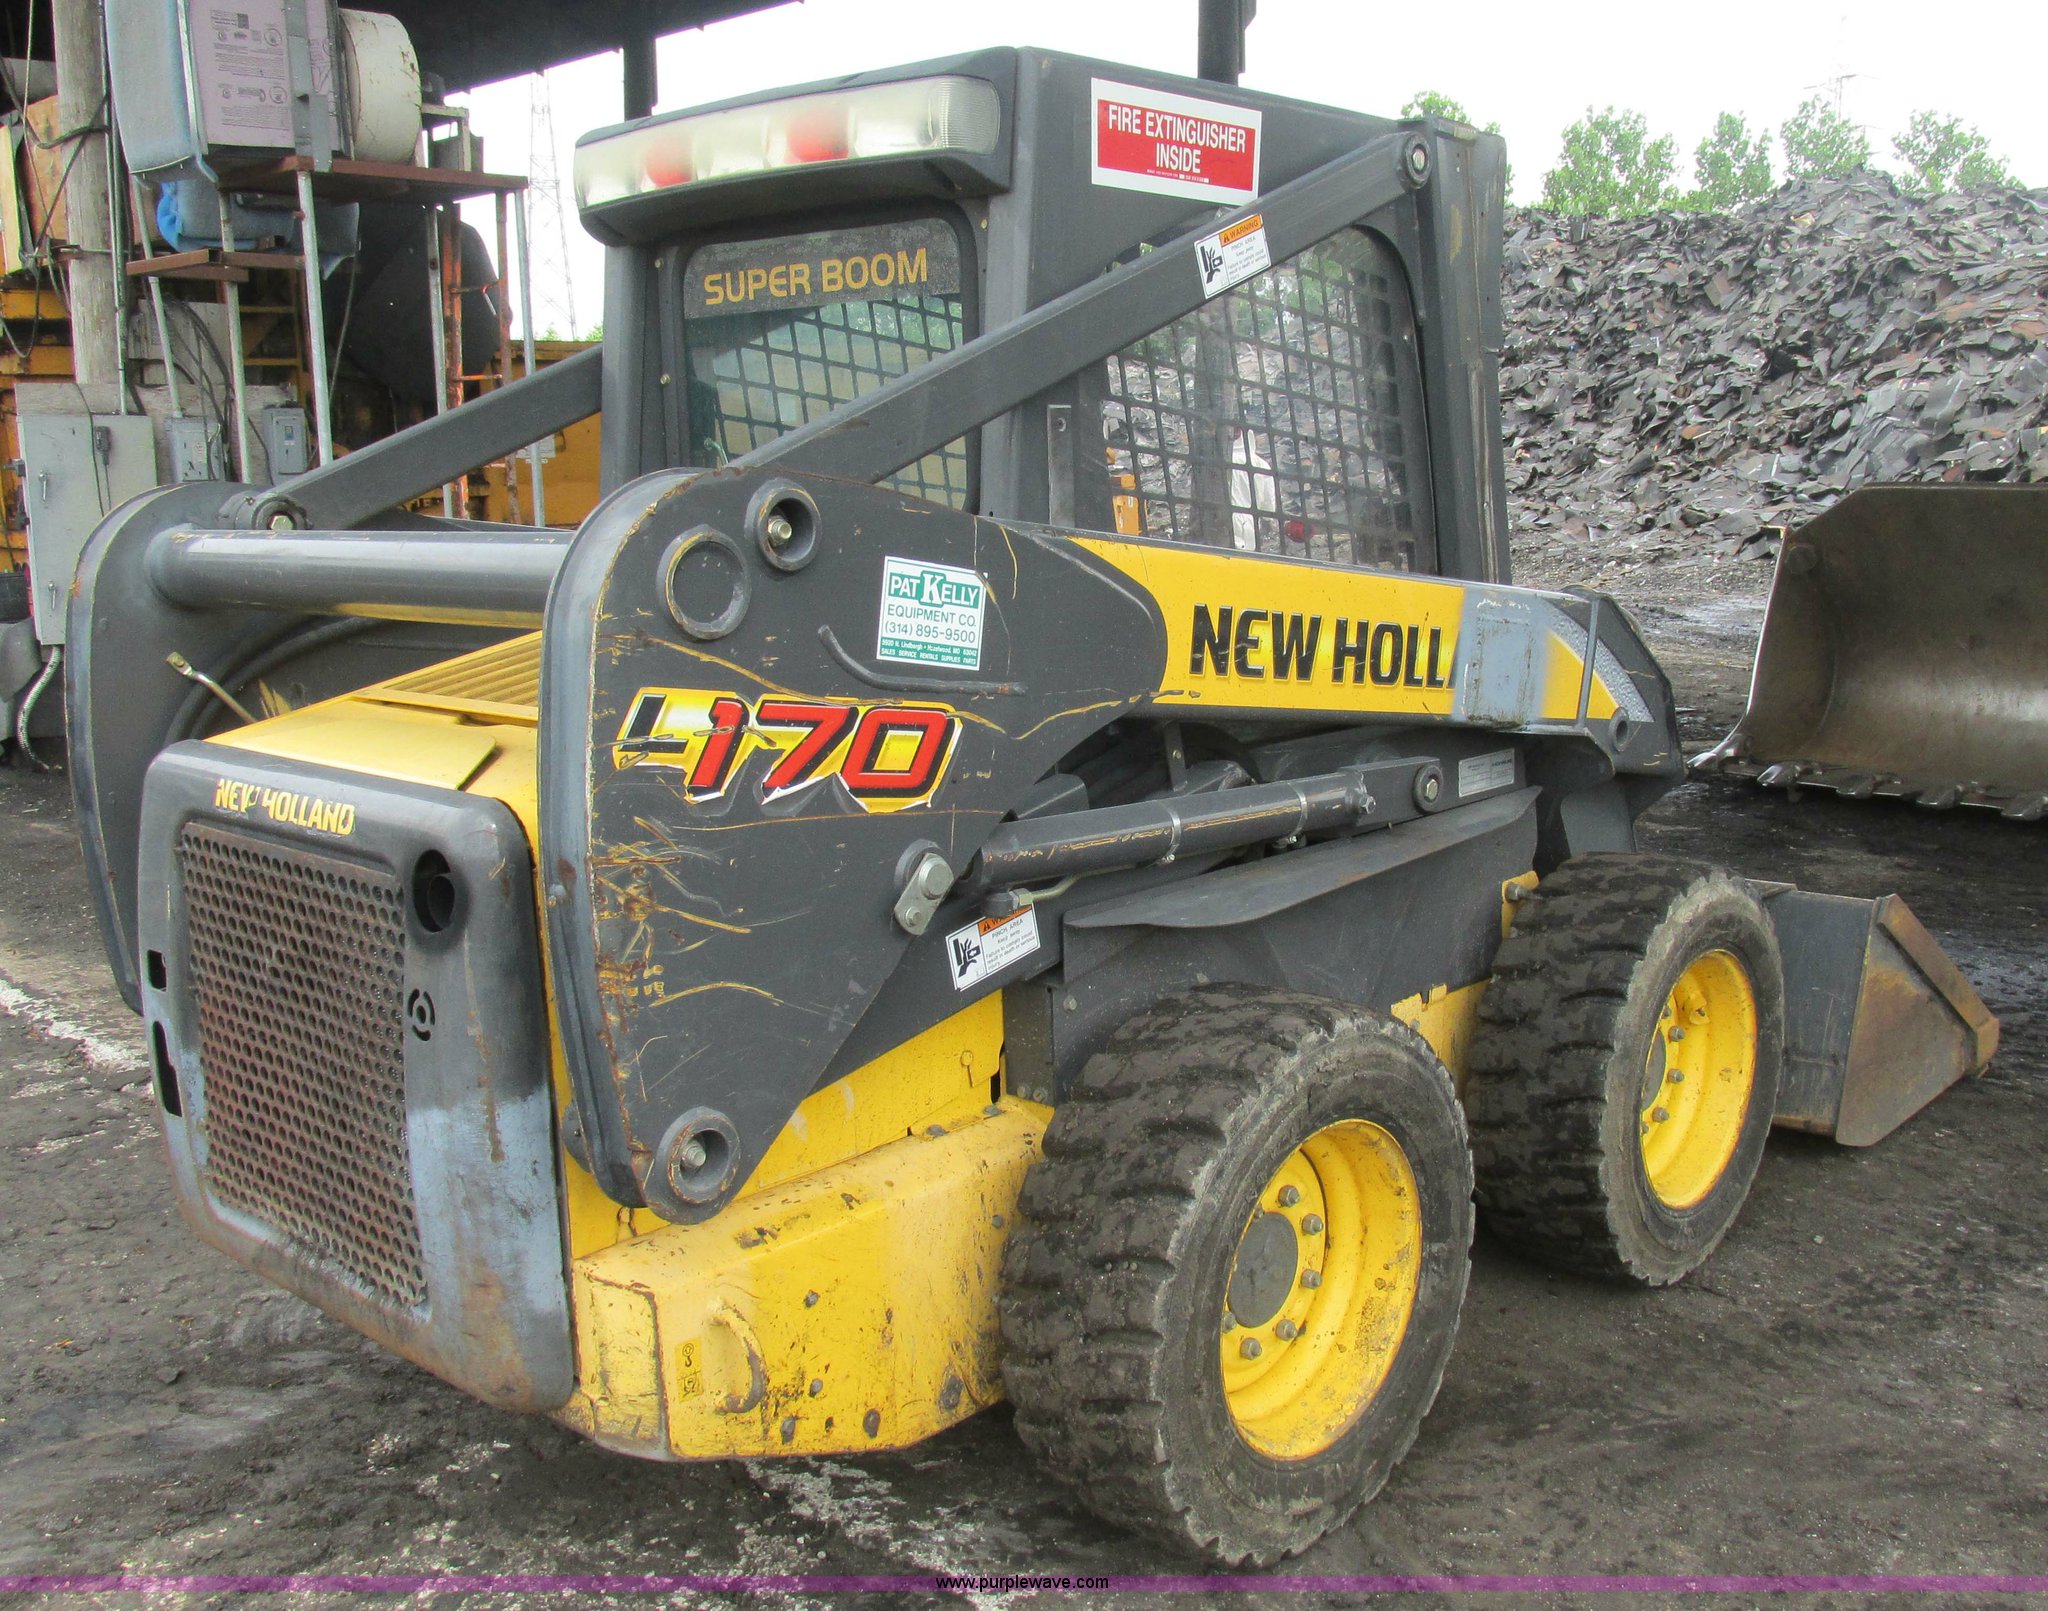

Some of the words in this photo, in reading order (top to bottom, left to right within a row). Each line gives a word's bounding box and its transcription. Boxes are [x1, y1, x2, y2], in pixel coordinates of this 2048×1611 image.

[1108, 104, 1141, 135] FIRE
[1145, 111, 1246, 153] EXTINGUISHER
[1156, 142, 1202, 174] INSIDE
[1229, 219, 1259, 239] WARNING
[704, 263, 811, 305] SUPER
[821, 247, 927, 293] BOOM
[890, 575, 920, 599] PAT
[921, 573, 978, 606] KELLY
[887, 603, 956, 625] EQUIPMENT
[959, 613, 977, 628] CO.
[885, 621, 913, 635] (314)
[915, 623, 976, 644] 895-9500
[1189, 603, 1322, 681] NEW
[1331, 617, 1455, 689] HOLL
